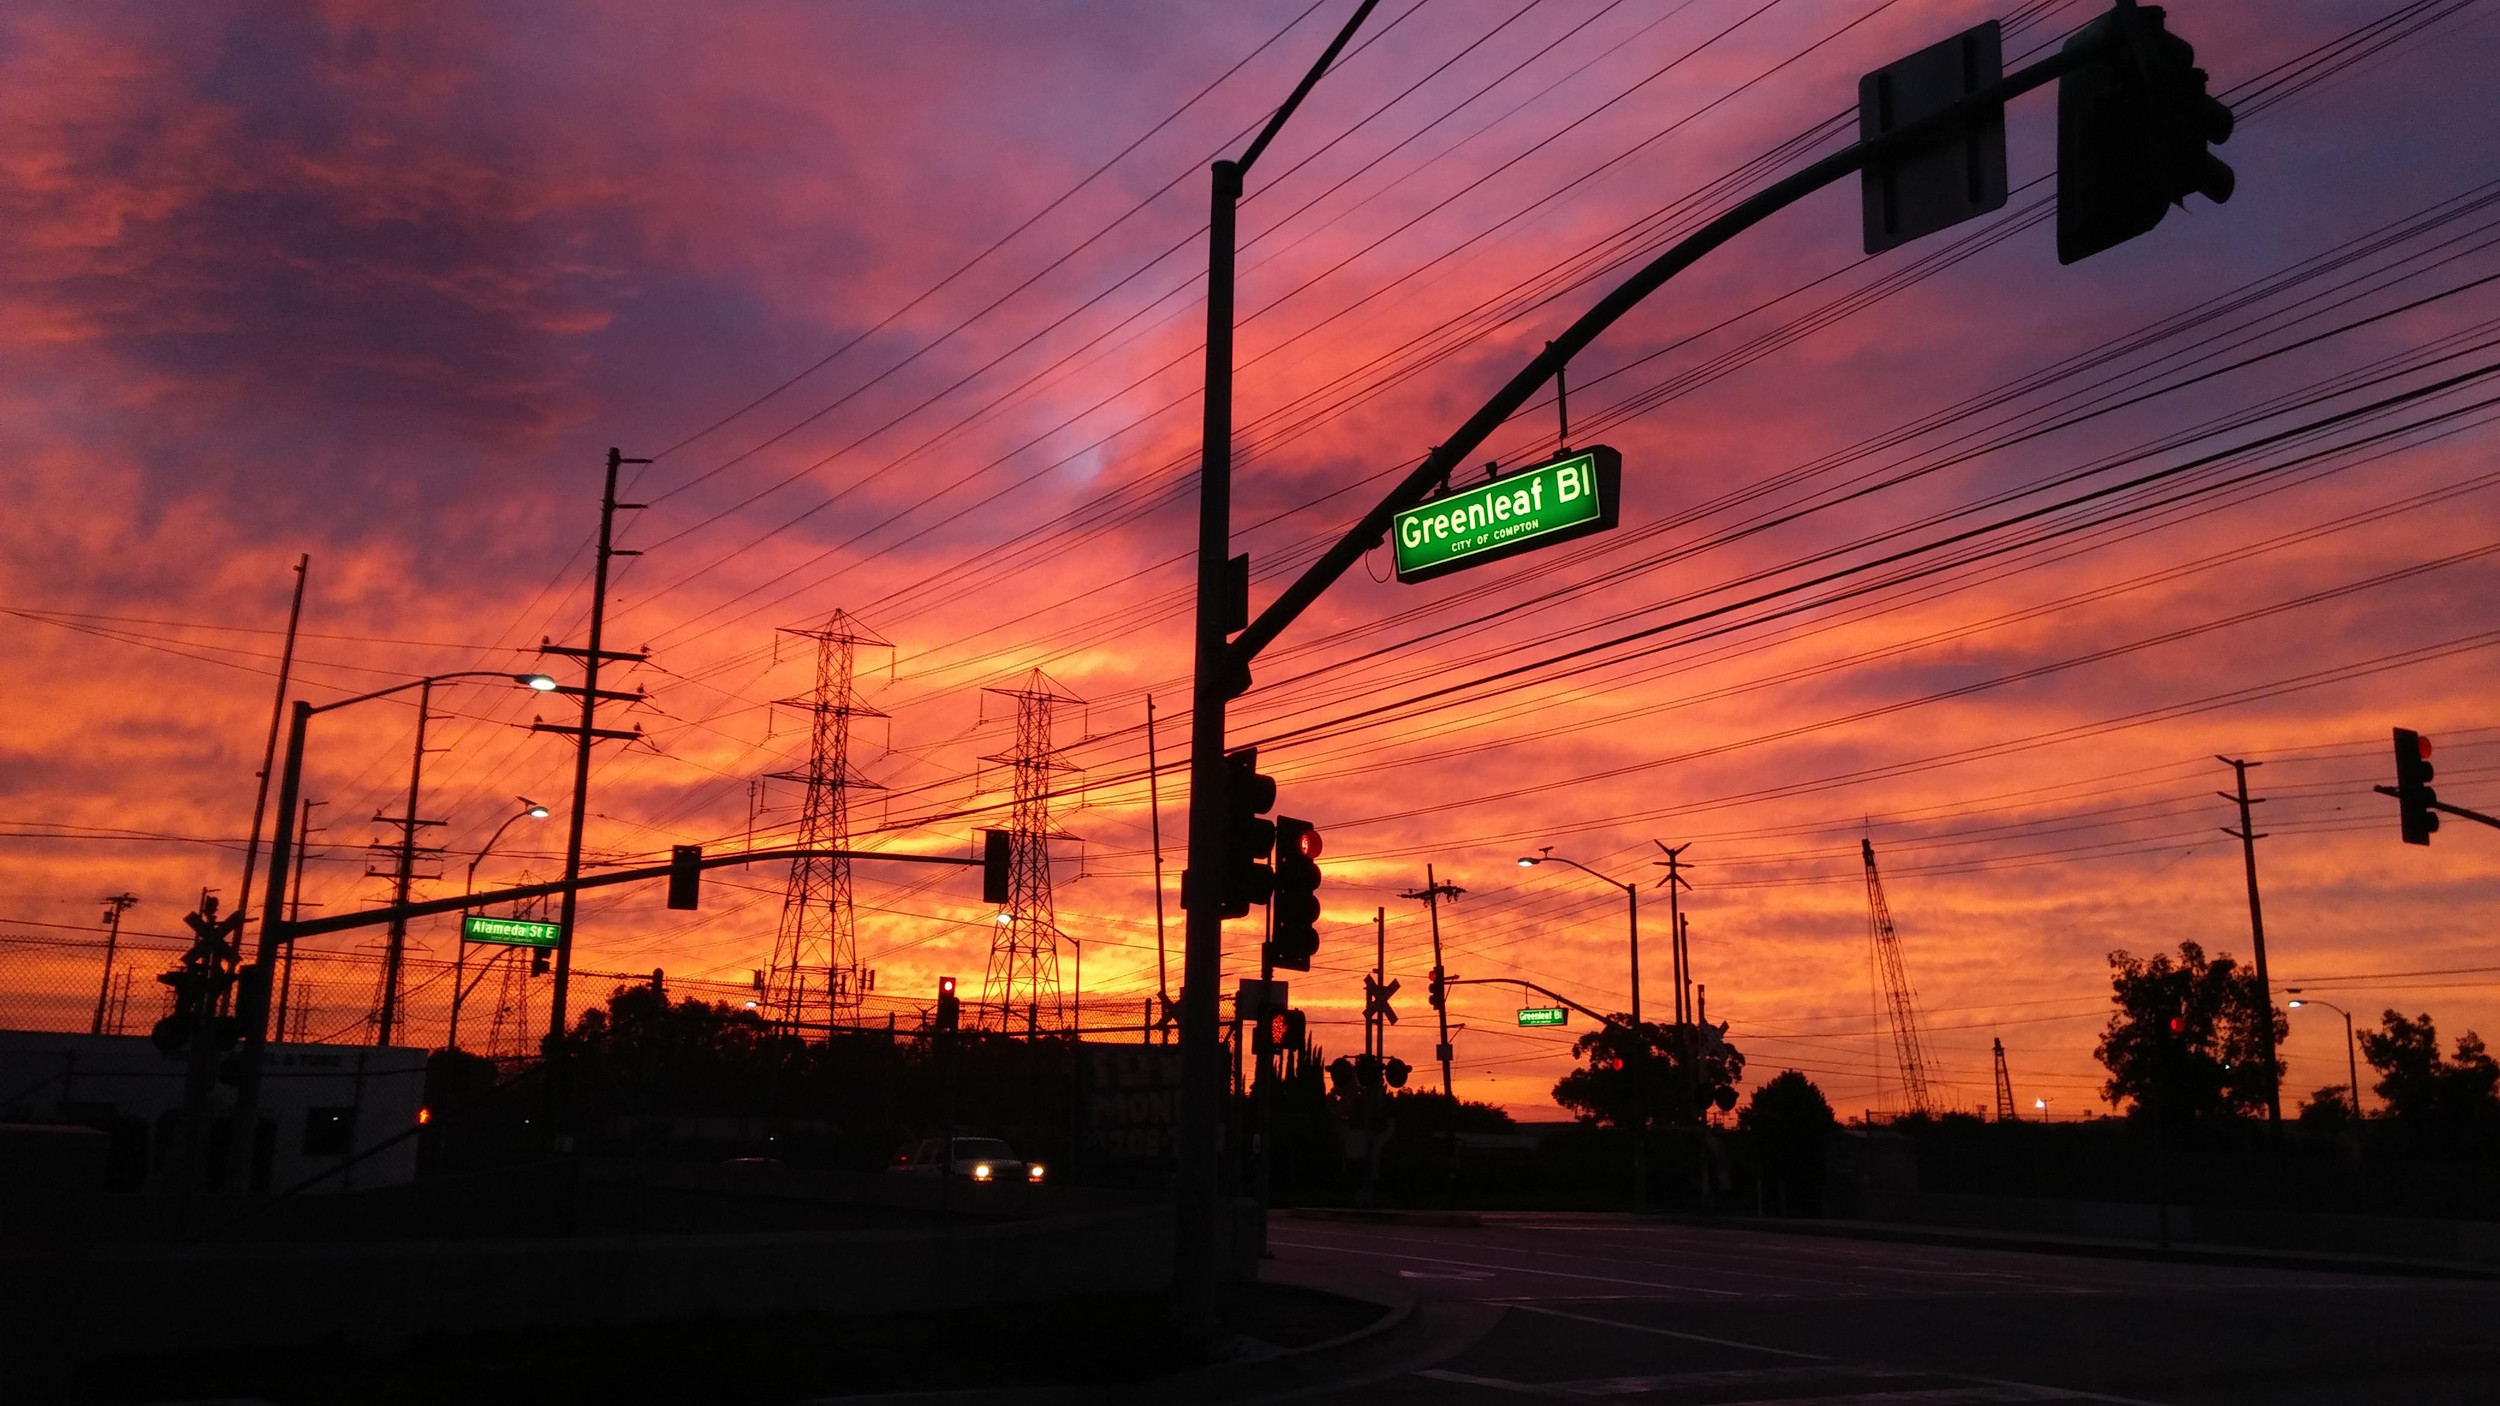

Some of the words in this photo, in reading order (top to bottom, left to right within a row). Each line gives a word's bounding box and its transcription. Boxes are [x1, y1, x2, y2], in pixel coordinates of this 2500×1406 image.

[1402, 476, 1543, 548] Greenleaf
[1451, 538, 1472, 552] CITY
[1477, 533, 1490, 545] OF
[1493, 519, 1539, 540] COMPTON
[472, 920, 526, 936] Alameda
[529, 925, 543, 938] St
[545, 927, 555, 939] E
